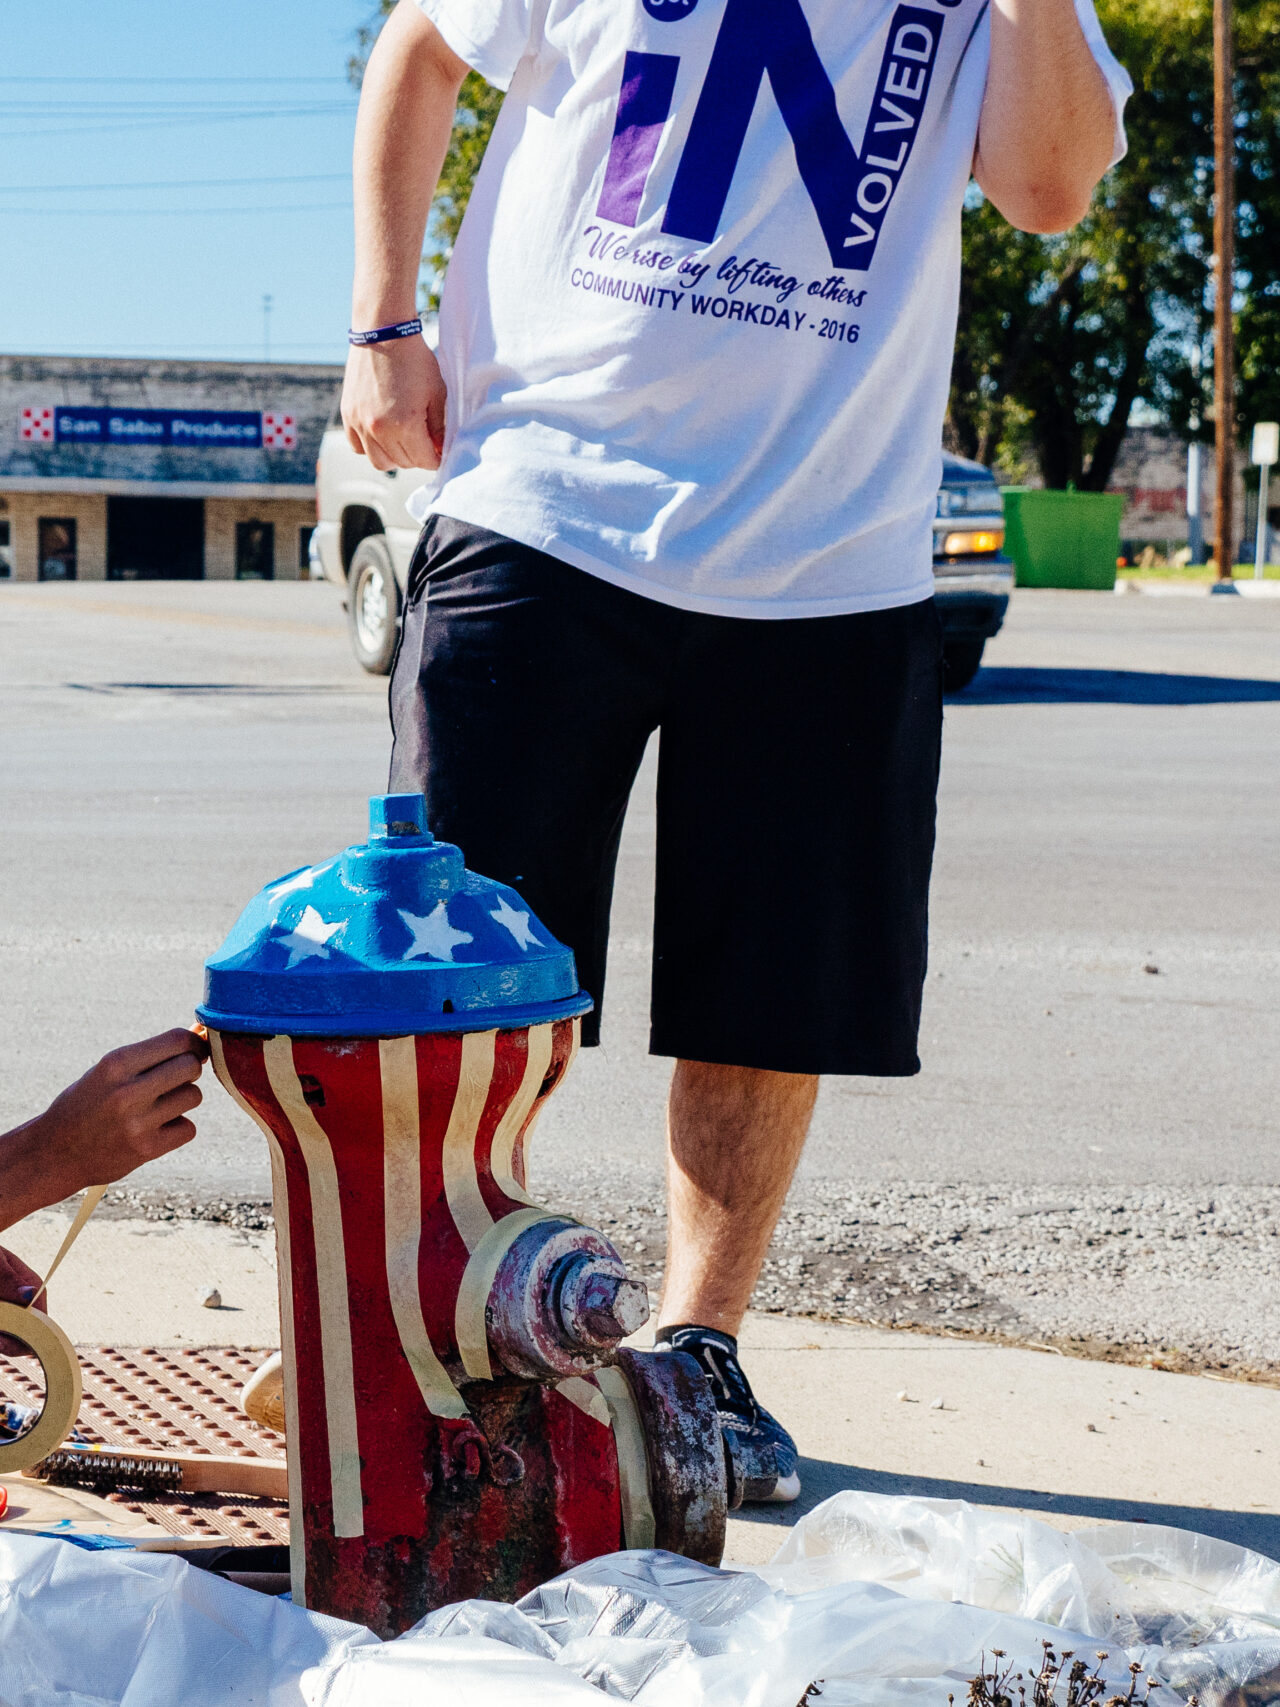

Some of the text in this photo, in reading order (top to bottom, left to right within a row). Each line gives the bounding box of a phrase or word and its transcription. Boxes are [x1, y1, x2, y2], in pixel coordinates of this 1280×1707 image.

[843, 23, 933, 247] VOLVED
[571, 267, 685, 312] COMMUNITY
[691, 293, 807, 332] WORKDAY
[818, 318, 861, 344] 2016
[583, 225, 868, 307] We rise by lifting others
[59, 415, 258, 438] San Saba Produce
